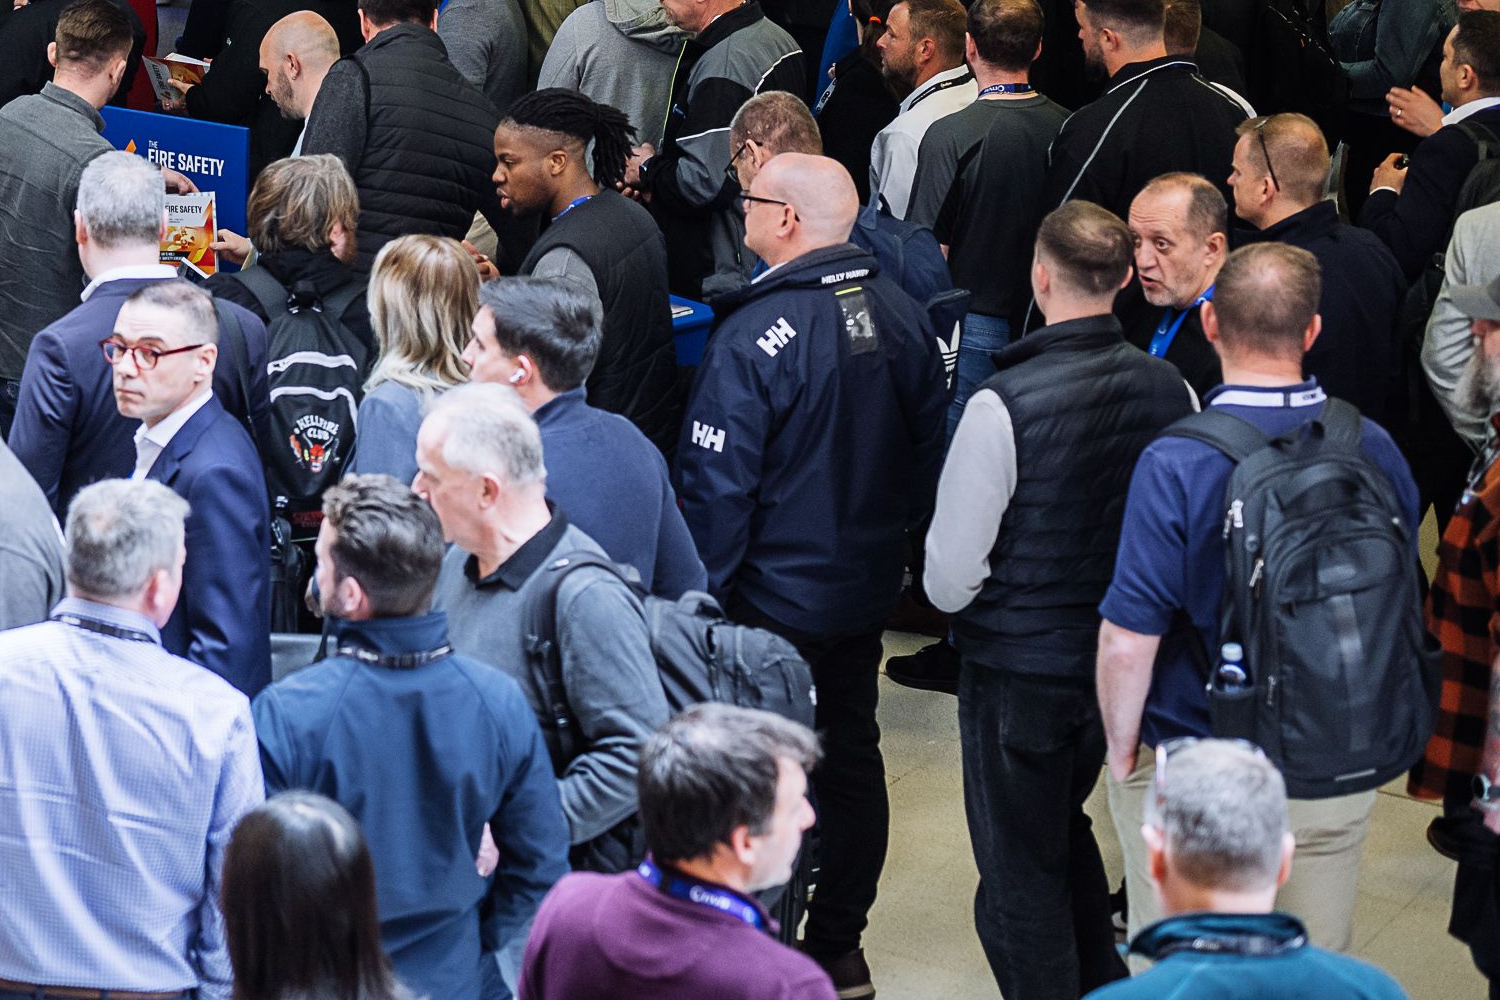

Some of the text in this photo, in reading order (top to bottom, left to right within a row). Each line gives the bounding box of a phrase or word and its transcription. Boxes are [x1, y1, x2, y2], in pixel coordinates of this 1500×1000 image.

[148, 140, 158, 149] THE
[147, 149, 225, 177] FIRE SAFETY
[180, 205, 203, 214] SAFETY
[756, 316, 797, 358] HH
[296, 414, 340, 436] HELLFIRE
[307, 427, 331, 441] CLUB
[691, 420, 726, 453] HH
